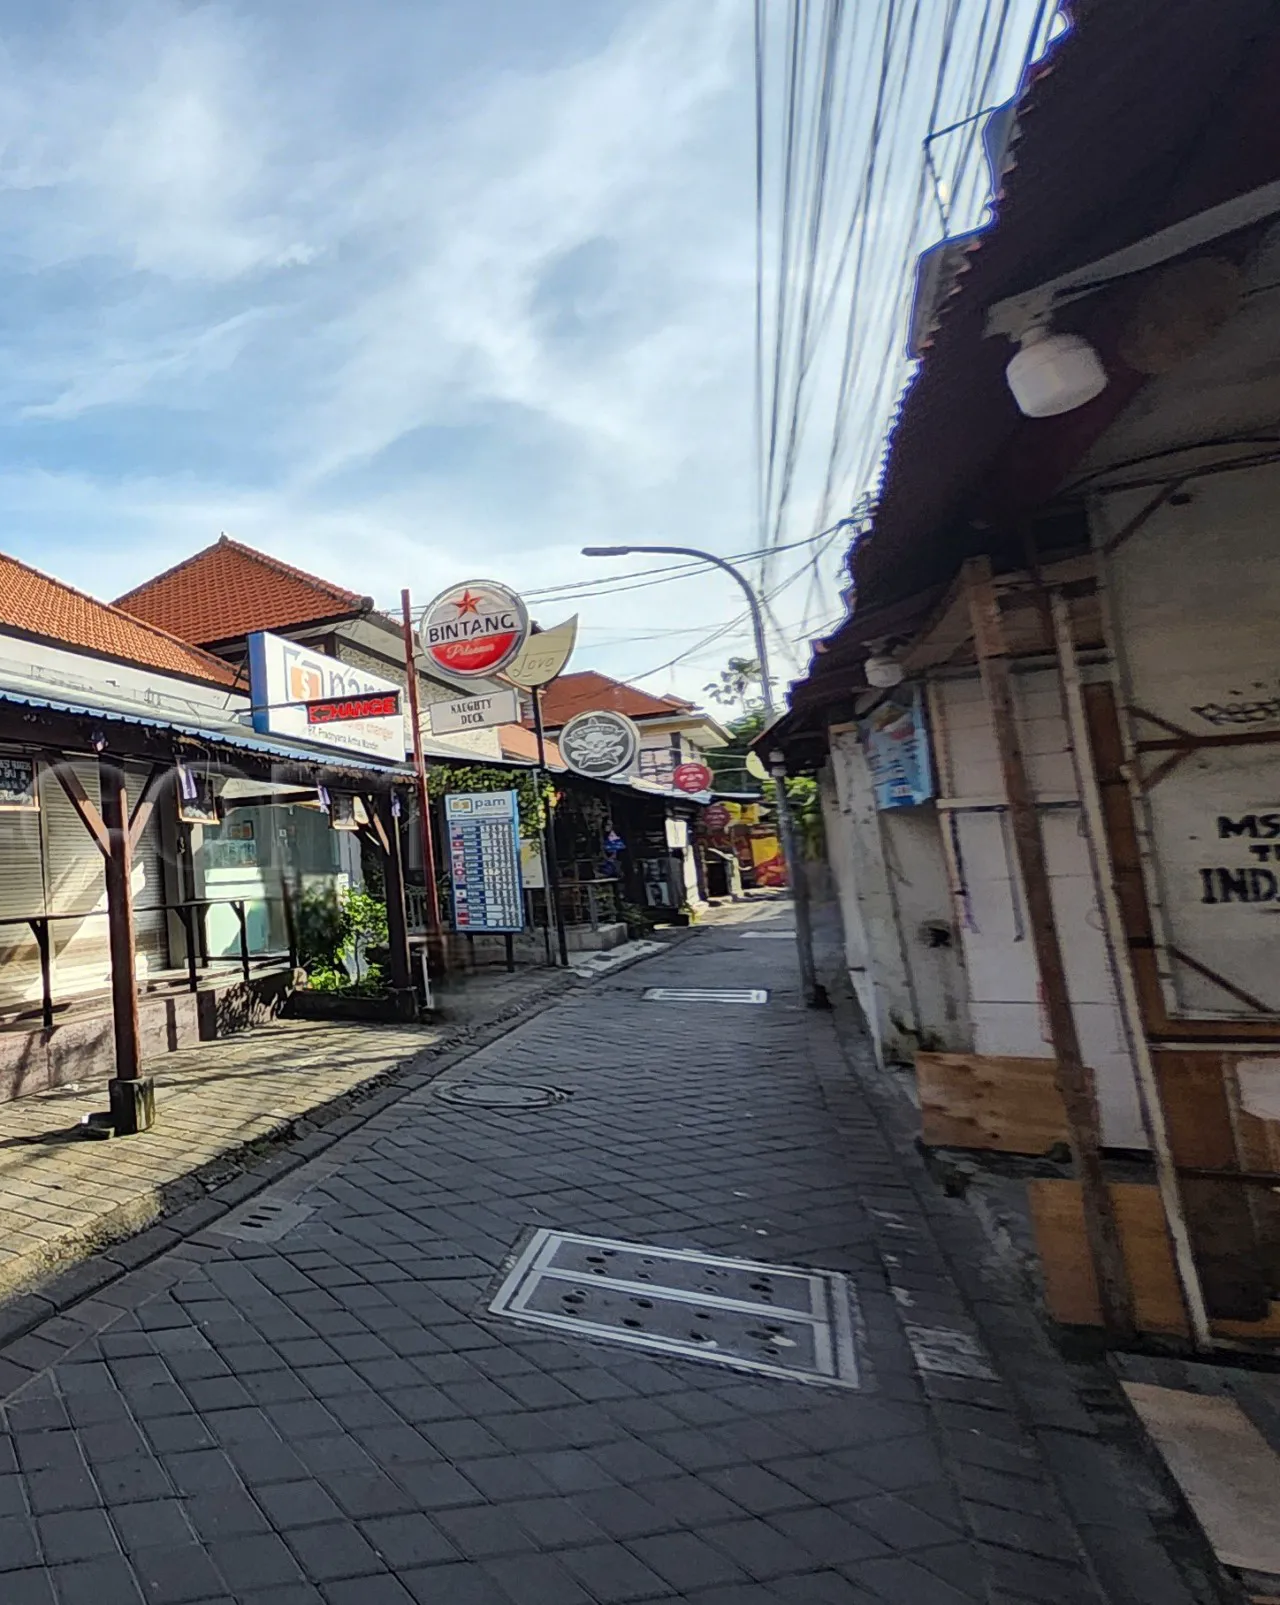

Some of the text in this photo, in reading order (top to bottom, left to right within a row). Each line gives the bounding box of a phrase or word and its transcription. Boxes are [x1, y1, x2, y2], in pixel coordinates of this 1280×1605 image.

[428, 613, 515, 643] BINTANG
[460, 712, 485, 725] DUCK
[475, 798, 506, 810] pam
